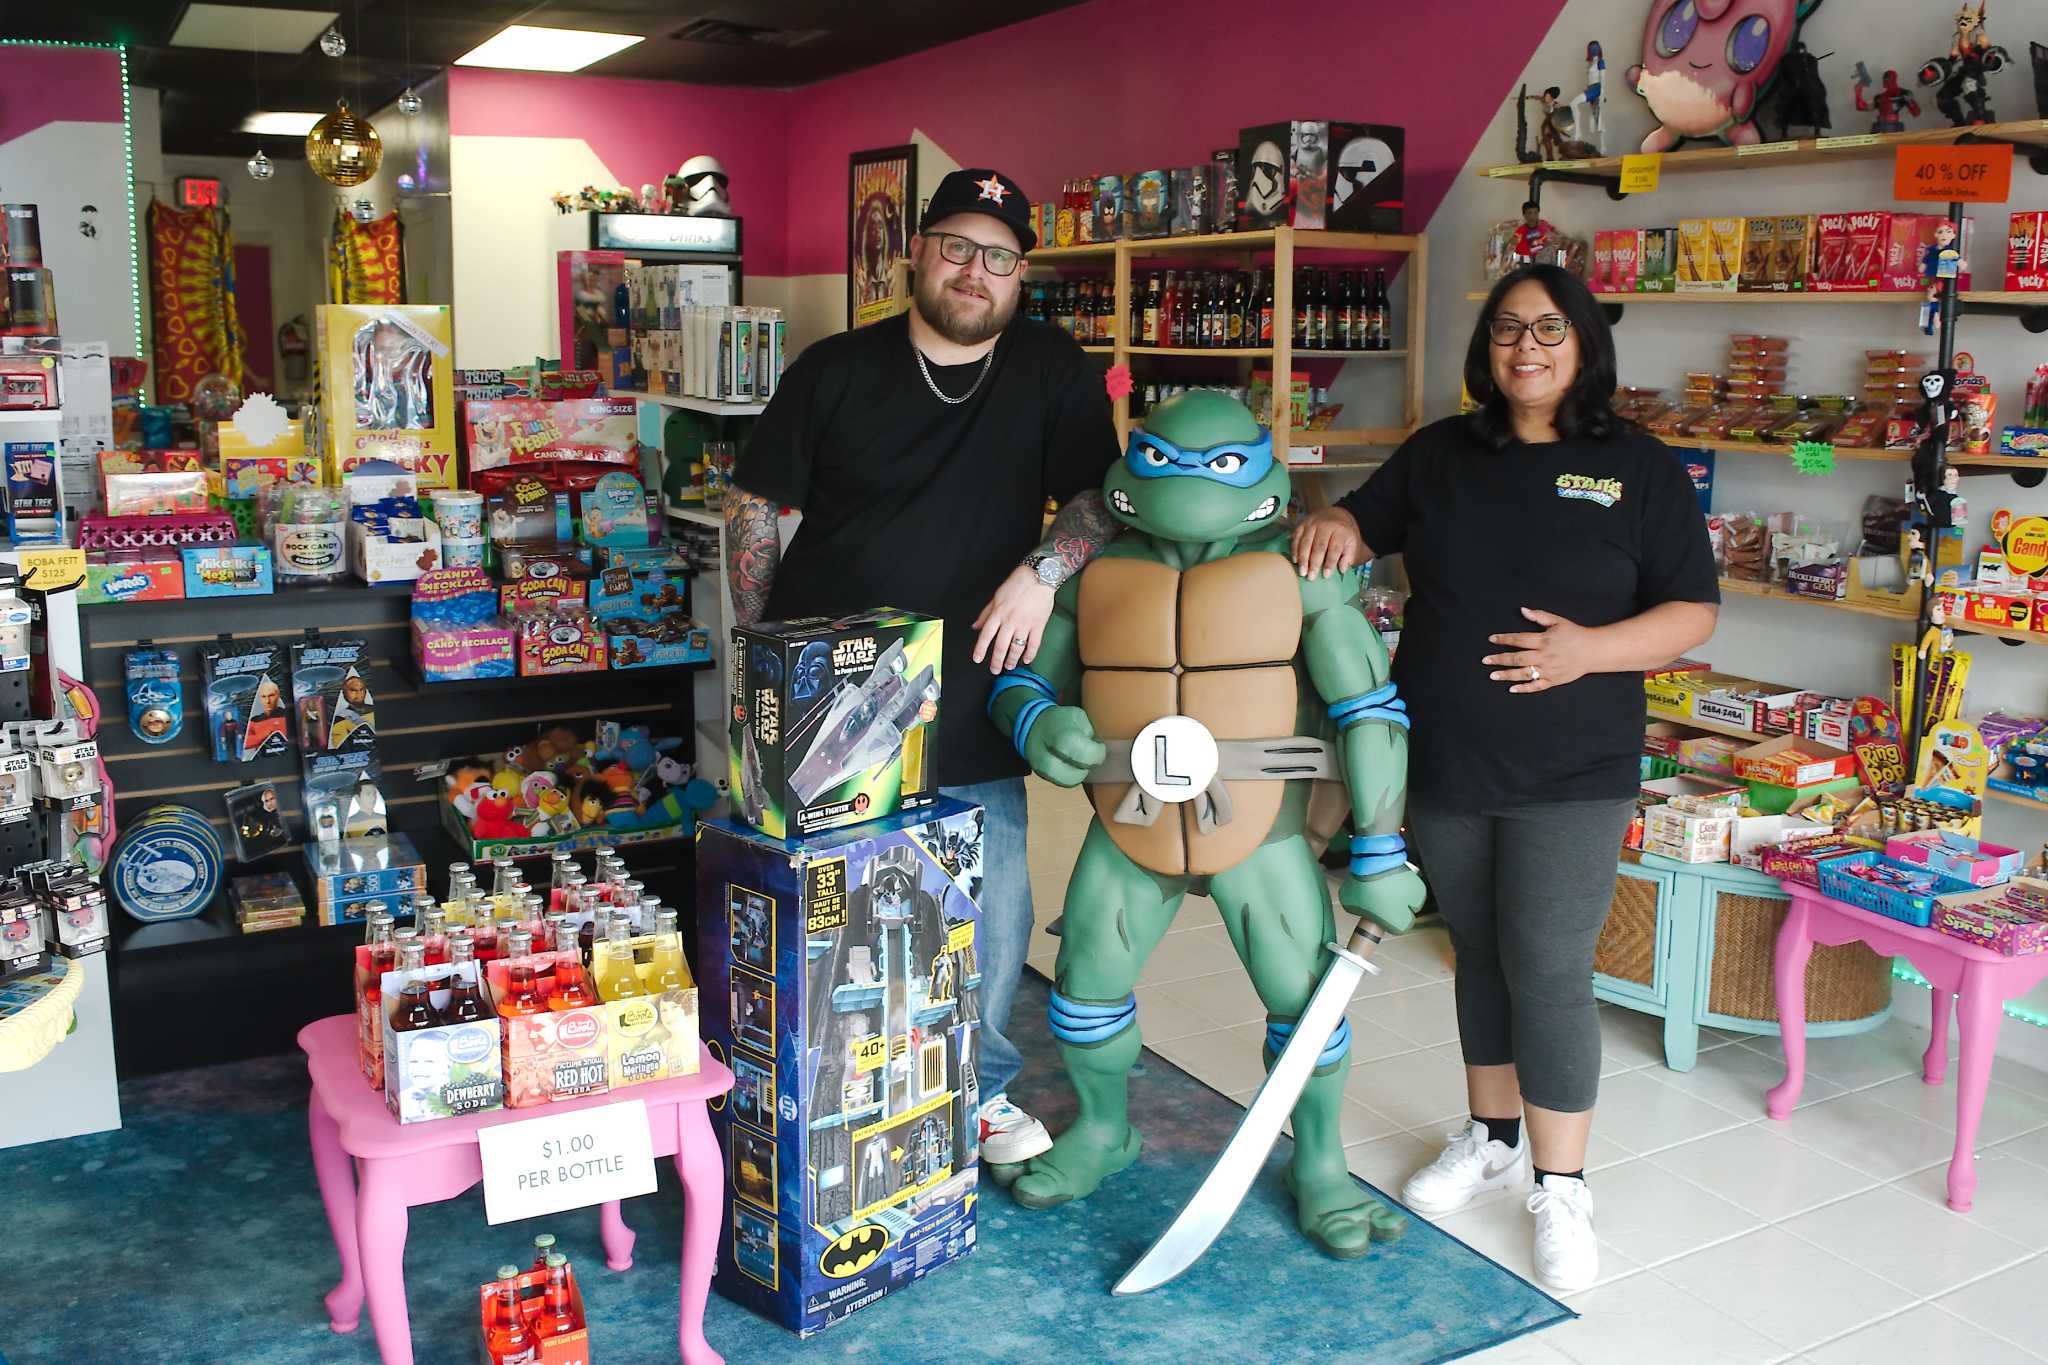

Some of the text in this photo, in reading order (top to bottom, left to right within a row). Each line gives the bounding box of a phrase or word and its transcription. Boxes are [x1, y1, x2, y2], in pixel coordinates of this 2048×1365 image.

[1914, 163, 1989, 180] 40 % OFF
[613, 405, 633, 413] SIZE
[27, 556, 78, 567] BOBA FETT
[433, 569, 477, 580] CANDY
[1789, 570, 1835, 585] HUCKLEBERRY
[105, 575, 147, 593] Nerds
[422, 578, 489, 591] NECKLACE
[520, 578, 567, 596] SODA CAN
[1812, 582, 1835, 593] GEMS
[1974, 604, 2007, 623] Candy
[427, 637, 509, 649] CANDY NECKLACE
[833, 637, 876, 654] STAR
[542, 643, 589, 663] SODA CAN
[833, 649, 876, 667] WARS
[761, 688, 772, 742] WARS
[766, 688, 779, 745] STAR
[1701, 703, 1743, 720] ABBA-ZABA
[74, 746, 96, 754] STAR
[74, 751, 96, 760] WARS
[1857, 744, 1899, 767] Ring
[5, 758, 28, 767] STAR
[5, 764, 28, 772] WARS
[1155, 735, 1191, 786] L
[801, 804, 849, 822] A-WING FIGHTER
[963, 825, 978, 839] DC
[818, 864, 834, 873] OVER
[817, 869, 841, 889] 33"
[813, 900, 831, 909] HAUT
[813, 906, 831, 916] PLUS
[808, 914, 840, 931] 83CM
[1943, 914, 1994, 938] Spree
[622, 1051, 660, 1065] Lemon
[860, 1041, 885, 1058] 40+
[555, 1064, 604, 1089] RED HOT
[623, 1062, 660, 1077] Meringue
[446, 1083, 496, 1104] DEWBERRY
[568, 1087, 591, 1095] SODA
[456, 1099, 487, 1109] SODA
[542, 1134, 594, 1159] $1.00
[518, 1155, 624, 1191] PER BOTTLE
[909, 1221, 935, 1239] BAT-TECH
[829, 1278, 867, 1300] WARNING:
[844, 1290, 883, 1314] ATTENTION
